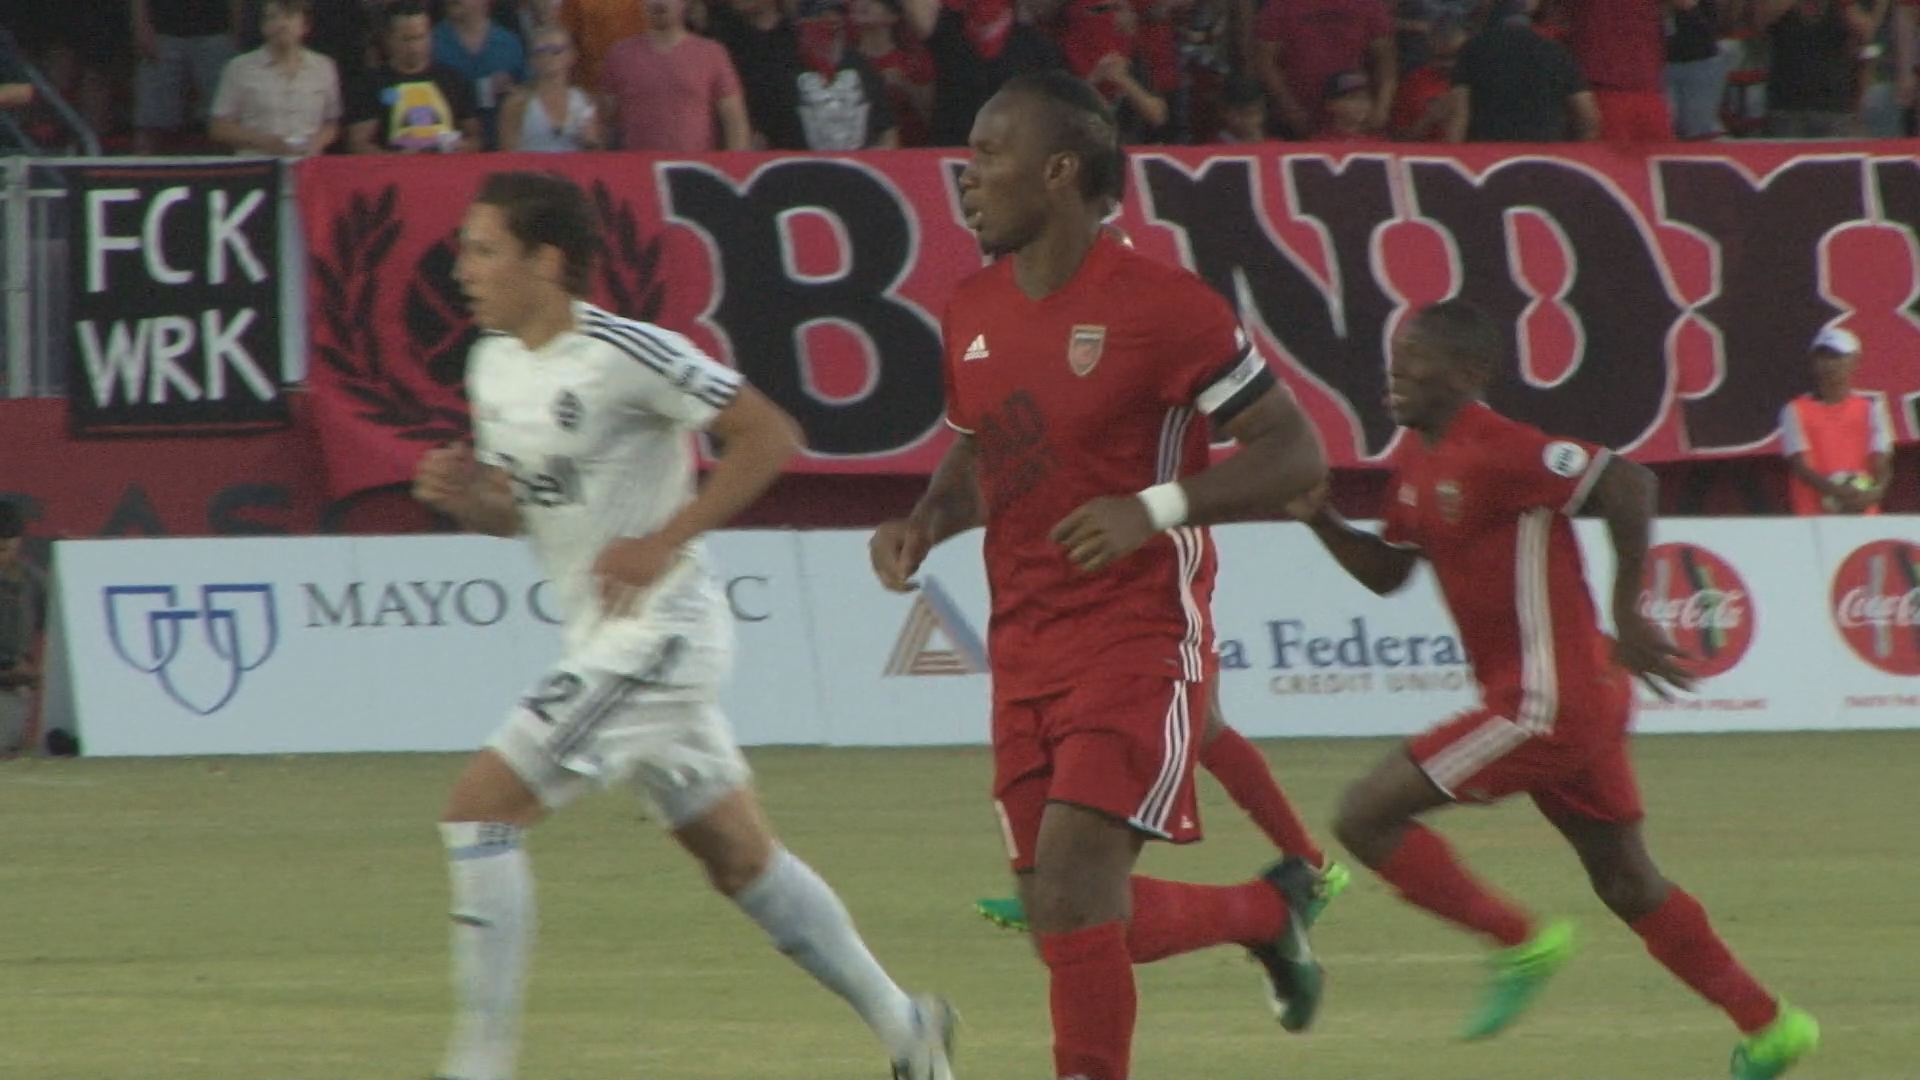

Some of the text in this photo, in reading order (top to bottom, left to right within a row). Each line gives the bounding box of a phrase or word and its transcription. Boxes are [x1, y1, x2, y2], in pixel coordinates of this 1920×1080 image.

[85, 186, 269, 293] FCK
[77, 308, 277, 408] WRK
[302, 578, 508, 628] MAYO
[1265, 615, 1470, 670] Federa
[1384, 670, 1474, 693] UNIO
